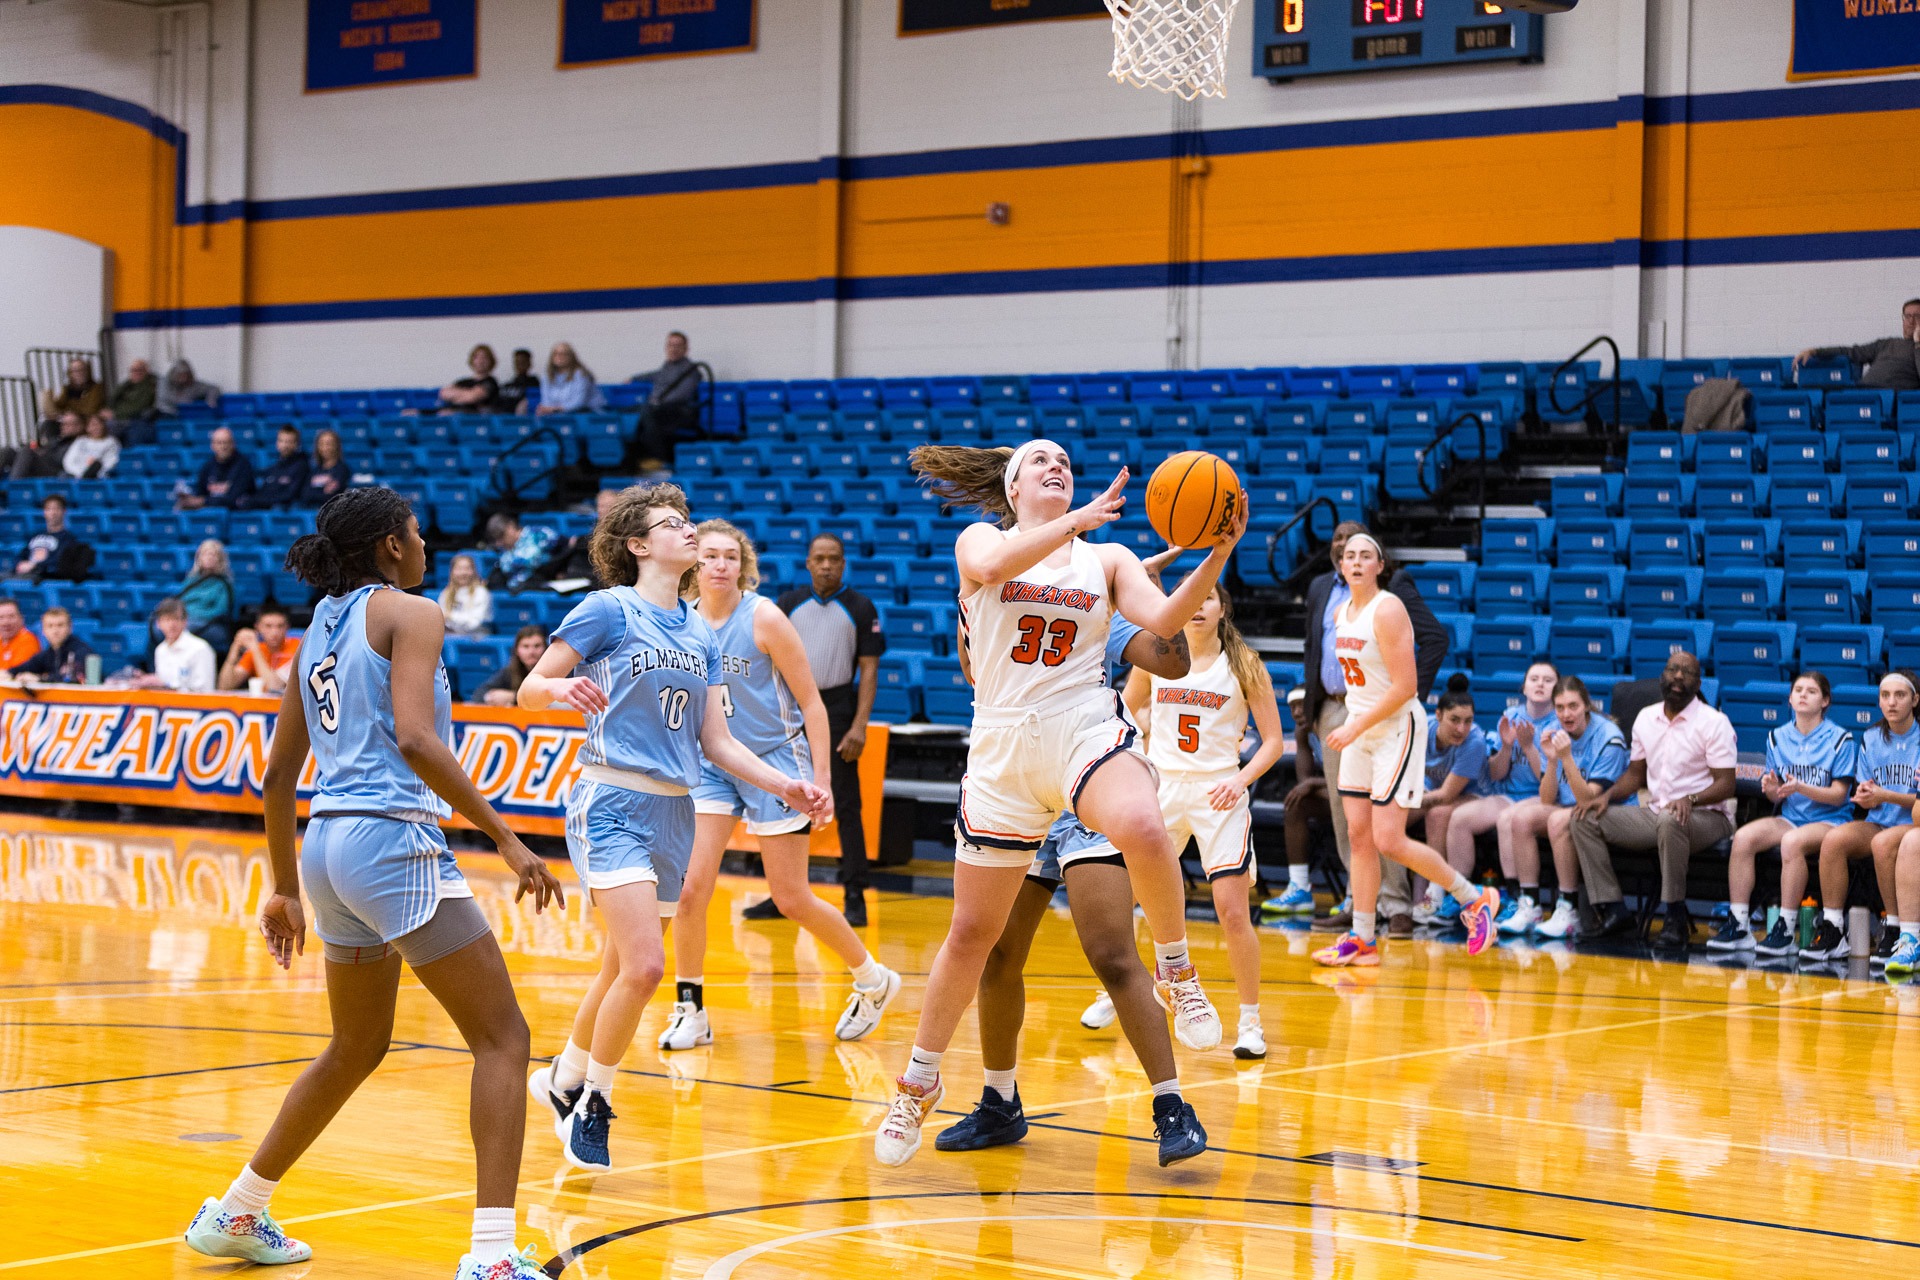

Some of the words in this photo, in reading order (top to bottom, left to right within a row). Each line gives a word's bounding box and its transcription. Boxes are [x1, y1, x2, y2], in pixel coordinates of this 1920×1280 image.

[1367, 37, 1407, 60] game
[1464, 29, 1496, 48] won
[1000, 581, 1100, 612] WHEATON
[1010, 614, 1078, 667] 33
[1338, 656, 1366, 687] 25
[308, 651, 340, 735] 5
[658, 685, 690, 731] 10
[1156, 688, 1231, 710] WHEATON
[0, 702, 277, 791] WHEATON
[1178, 714, 1200, 753] 5
